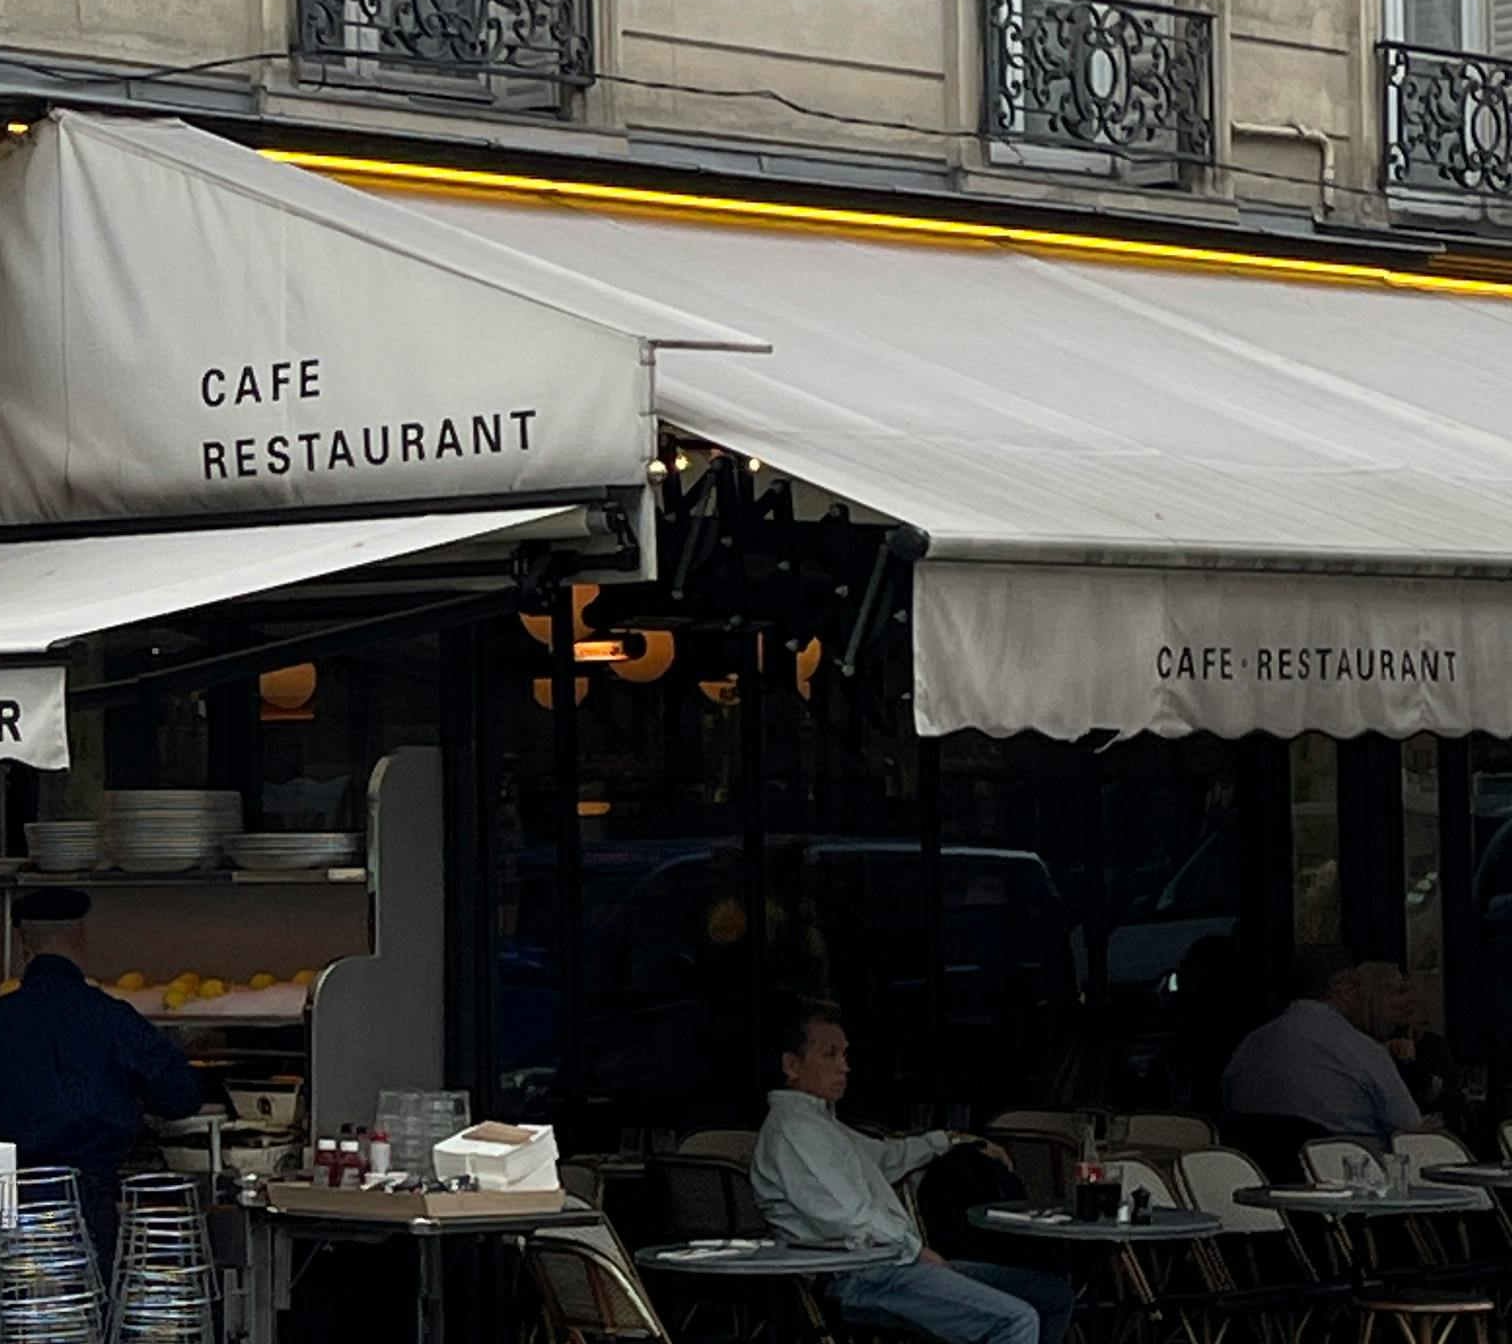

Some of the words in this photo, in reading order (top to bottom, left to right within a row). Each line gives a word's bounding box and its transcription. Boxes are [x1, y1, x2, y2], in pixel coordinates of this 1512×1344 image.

[201, 358, 321, 408] CAFE
[202, 409, 537, 481] RESTAURANT
[1256, 646, 1458, 683] RESTAURANT
